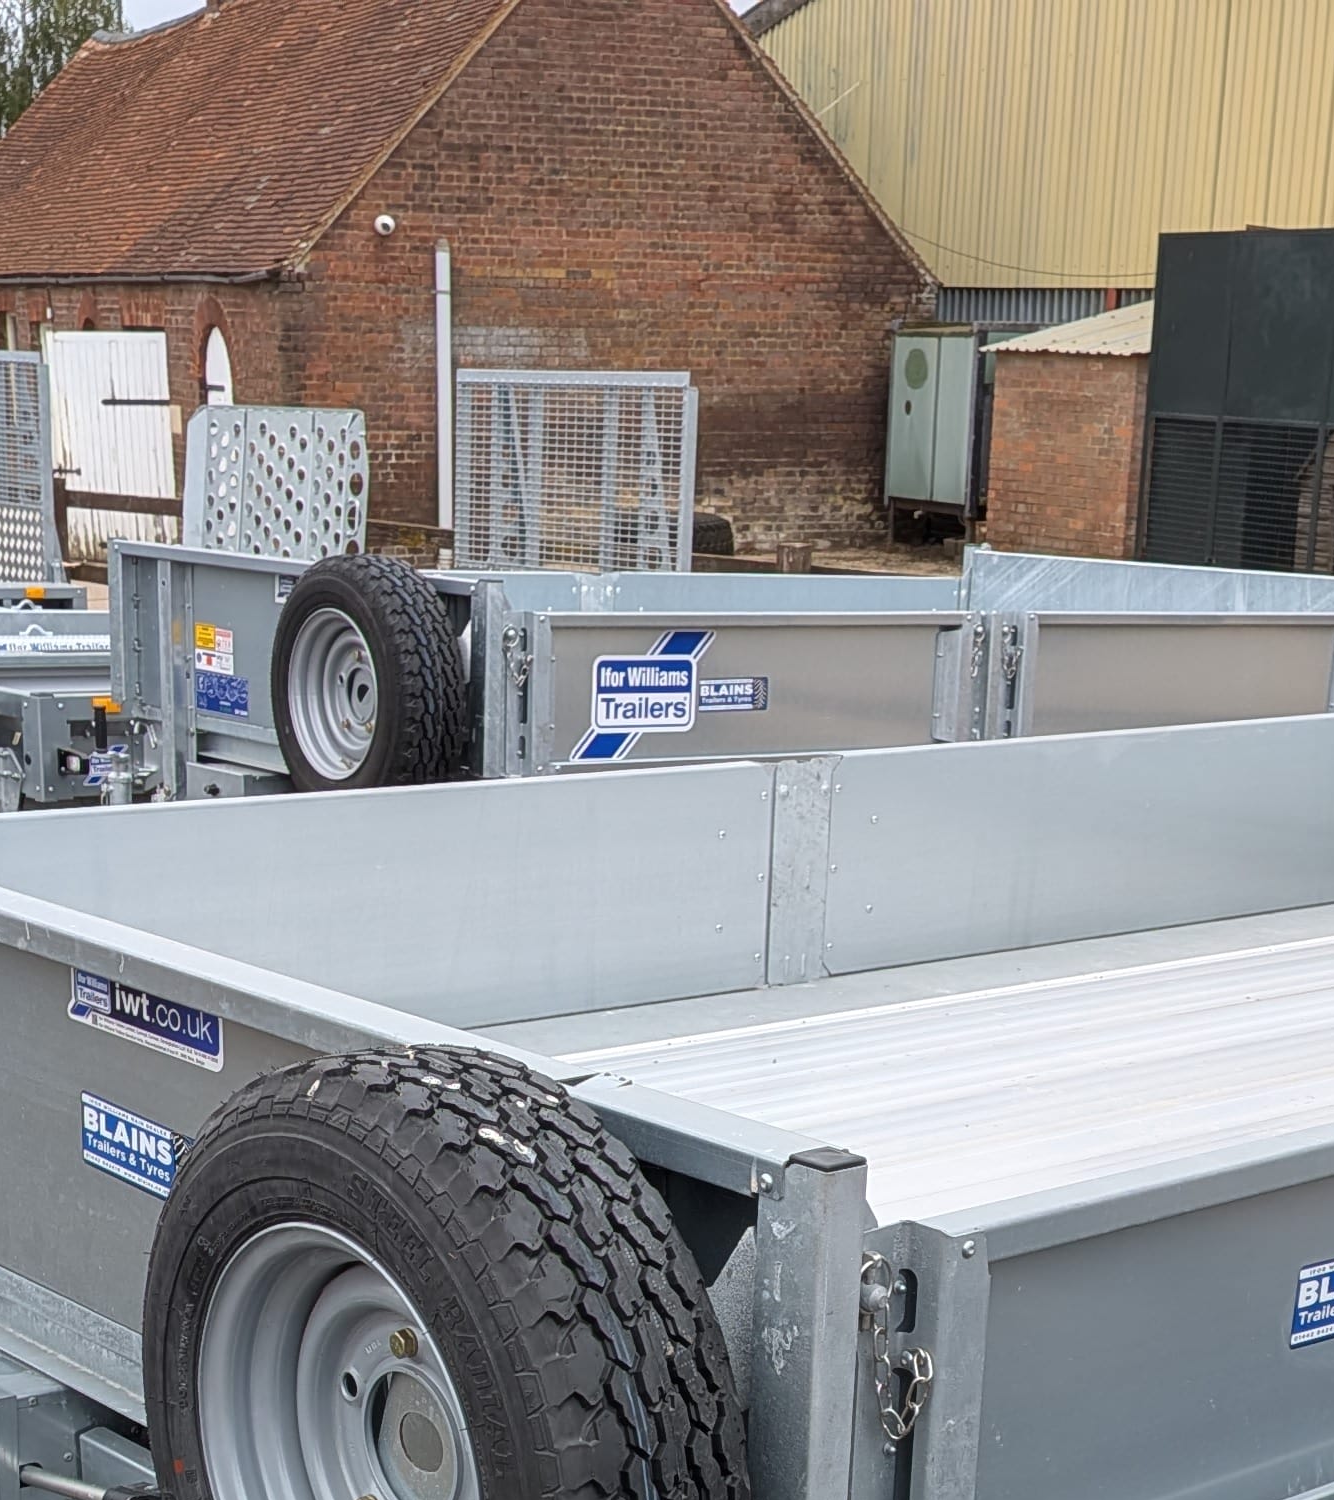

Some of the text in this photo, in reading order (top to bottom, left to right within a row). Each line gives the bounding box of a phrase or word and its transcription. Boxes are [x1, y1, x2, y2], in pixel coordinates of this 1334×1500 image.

[75, 642, 109, 652] Trailer
[600, 666, 689, 688] Ifor Williams
[700, 683, 754, 697] BLAINS
[600, 696, 687, 720] Trailers
[78, 987, 108, 1008] Trailers
[114, 983, 214, 1045] iwt.co.uk
[83, 1105, 173, 1166] BLAINS
[85, 1133, 172, 1183] Trailers & Tyres
[345, 1172, 514, 1482] STEEL RADIAL
